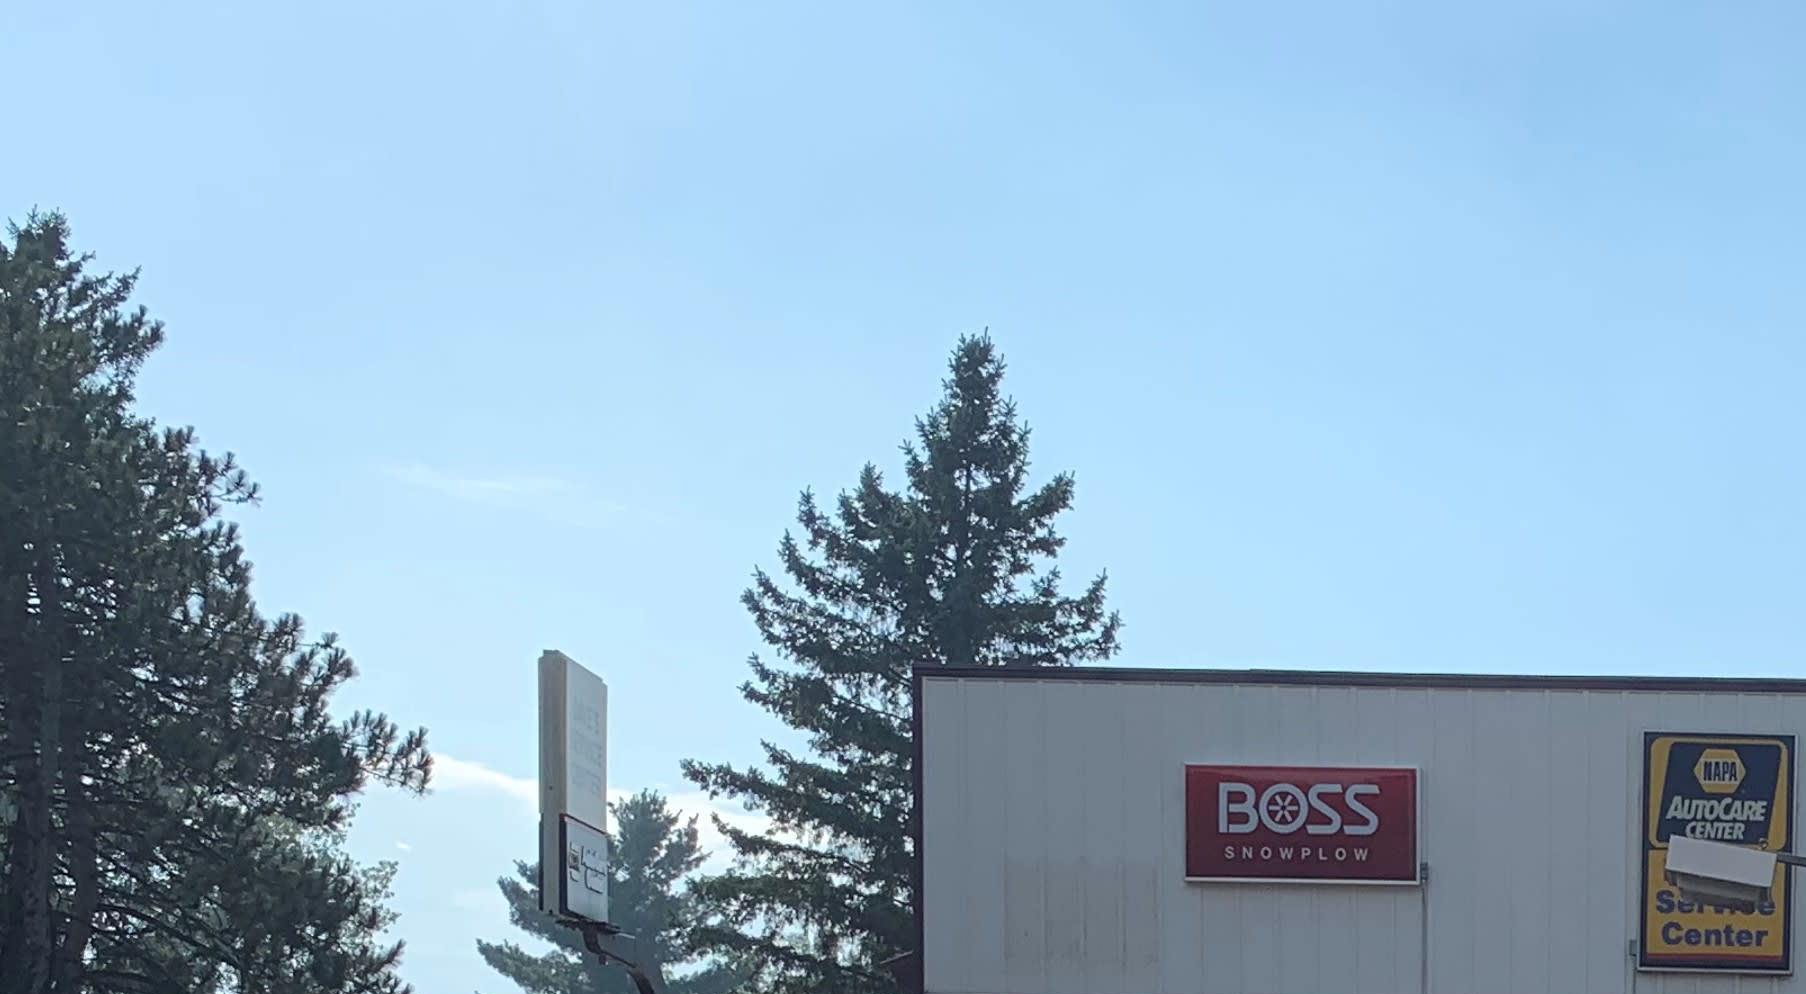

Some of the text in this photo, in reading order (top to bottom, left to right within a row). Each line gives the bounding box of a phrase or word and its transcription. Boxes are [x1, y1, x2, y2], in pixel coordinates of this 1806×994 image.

[1703, 760, 1738, 782] NAPA
[1218, 782, 1381, 835] BOSS
[1685, 821, 1745, 840] CENTER
[1224, 846, 1369, 861] SNOWPLOW
[1662, 921, 1769, 947] Center
